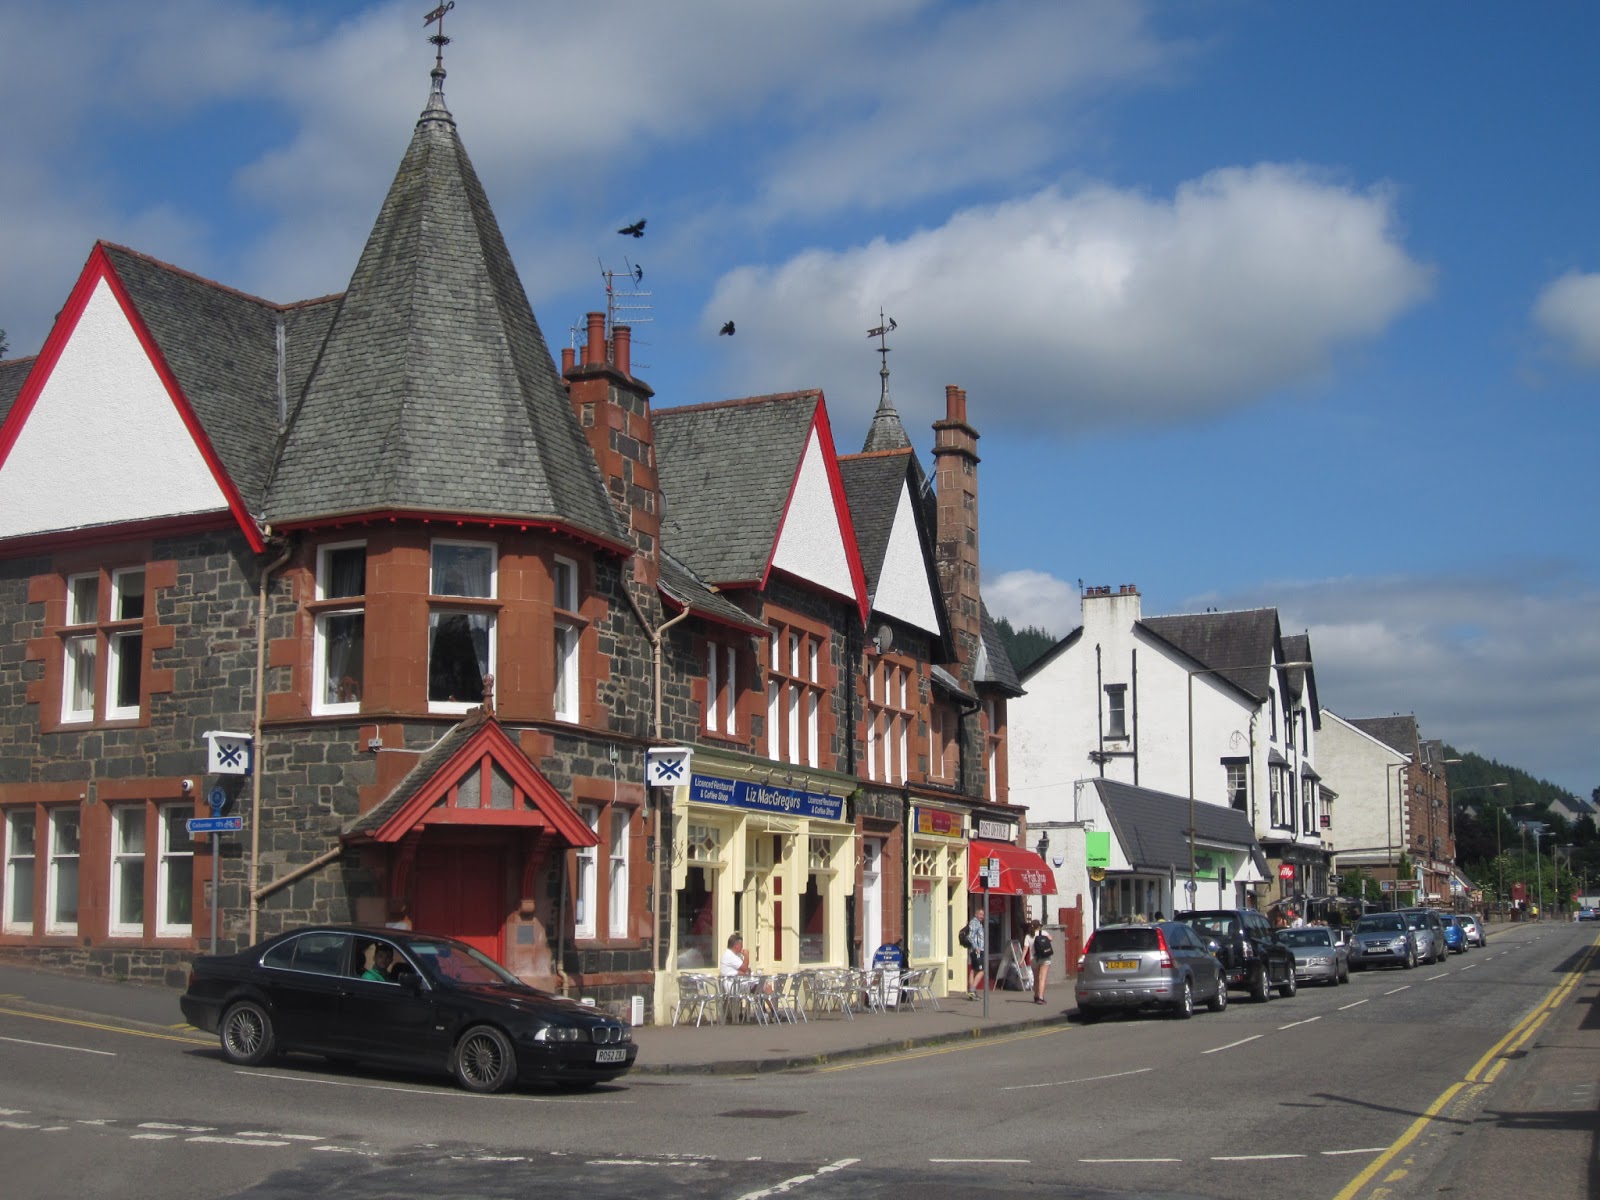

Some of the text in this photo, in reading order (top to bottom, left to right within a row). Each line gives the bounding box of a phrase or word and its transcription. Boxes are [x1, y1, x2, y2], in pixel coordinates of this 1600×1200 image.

[704, 789, 718, 800] Coffee
[718, 791, 729, 803] Shop
[745, 786, 801, 811] Liz MacGregors
[814, 806, 826, 815] Coffee
[825, 807, 835, 817] Shop
[980, 821, 1008, 838] POST OFFICE
[1280, 867, 1294, 878] illy
